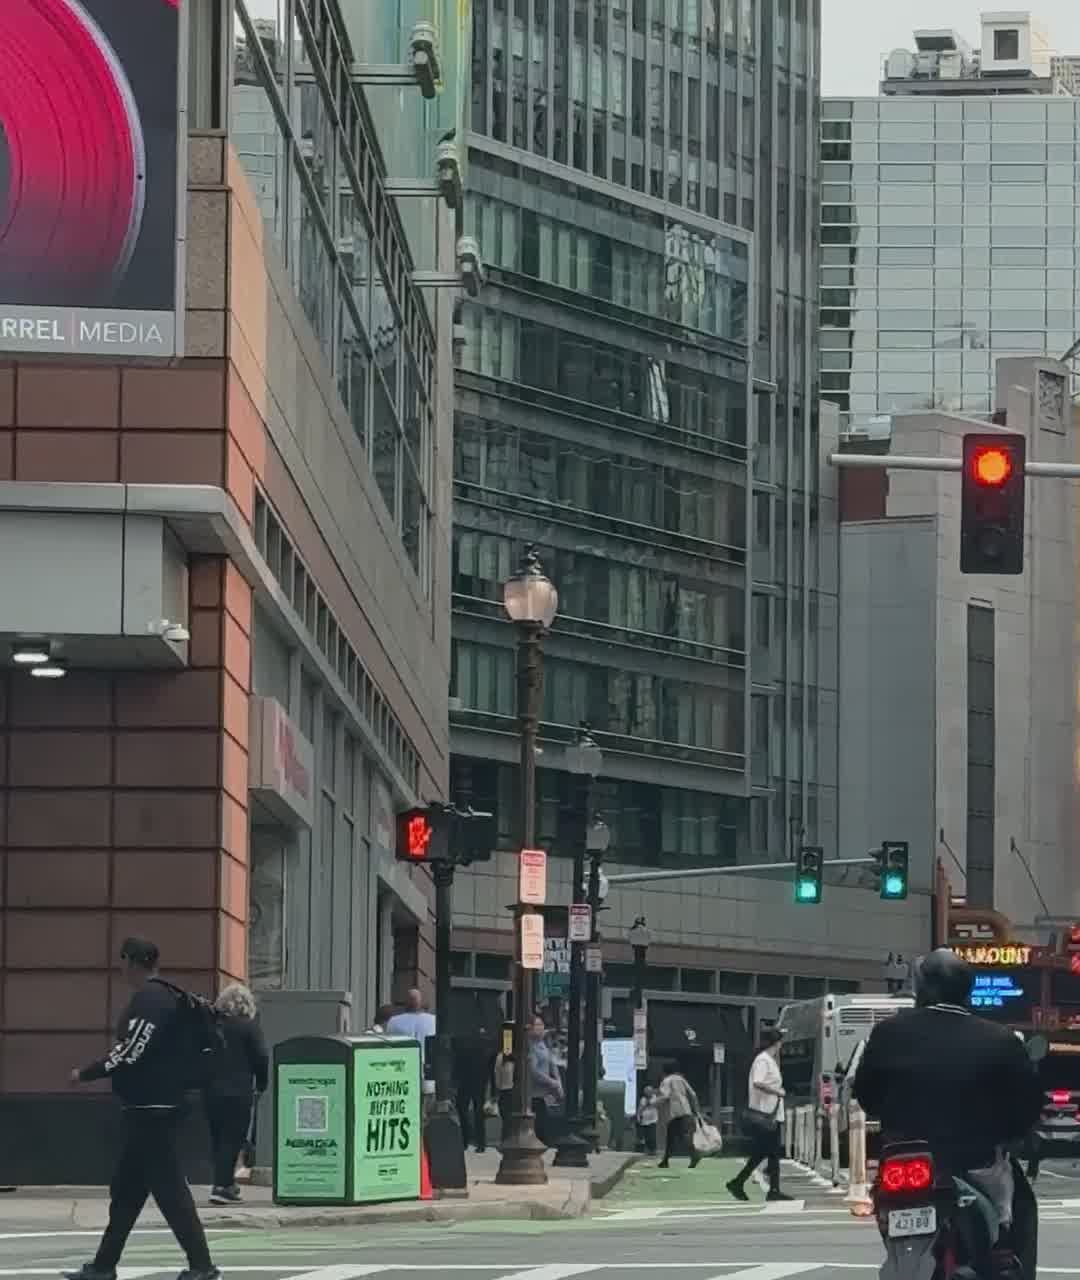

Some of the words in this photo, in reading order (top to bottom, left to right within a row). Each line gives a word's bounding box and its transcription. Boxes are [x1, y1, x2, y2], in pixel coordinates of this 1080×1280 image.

[0, 318, 65, 341] RREL
[79, 320, 163, 344] MEDIA
[365, 1080, 409, 1097] NOTHING
[366, 1117, 410, 1152] HITS
